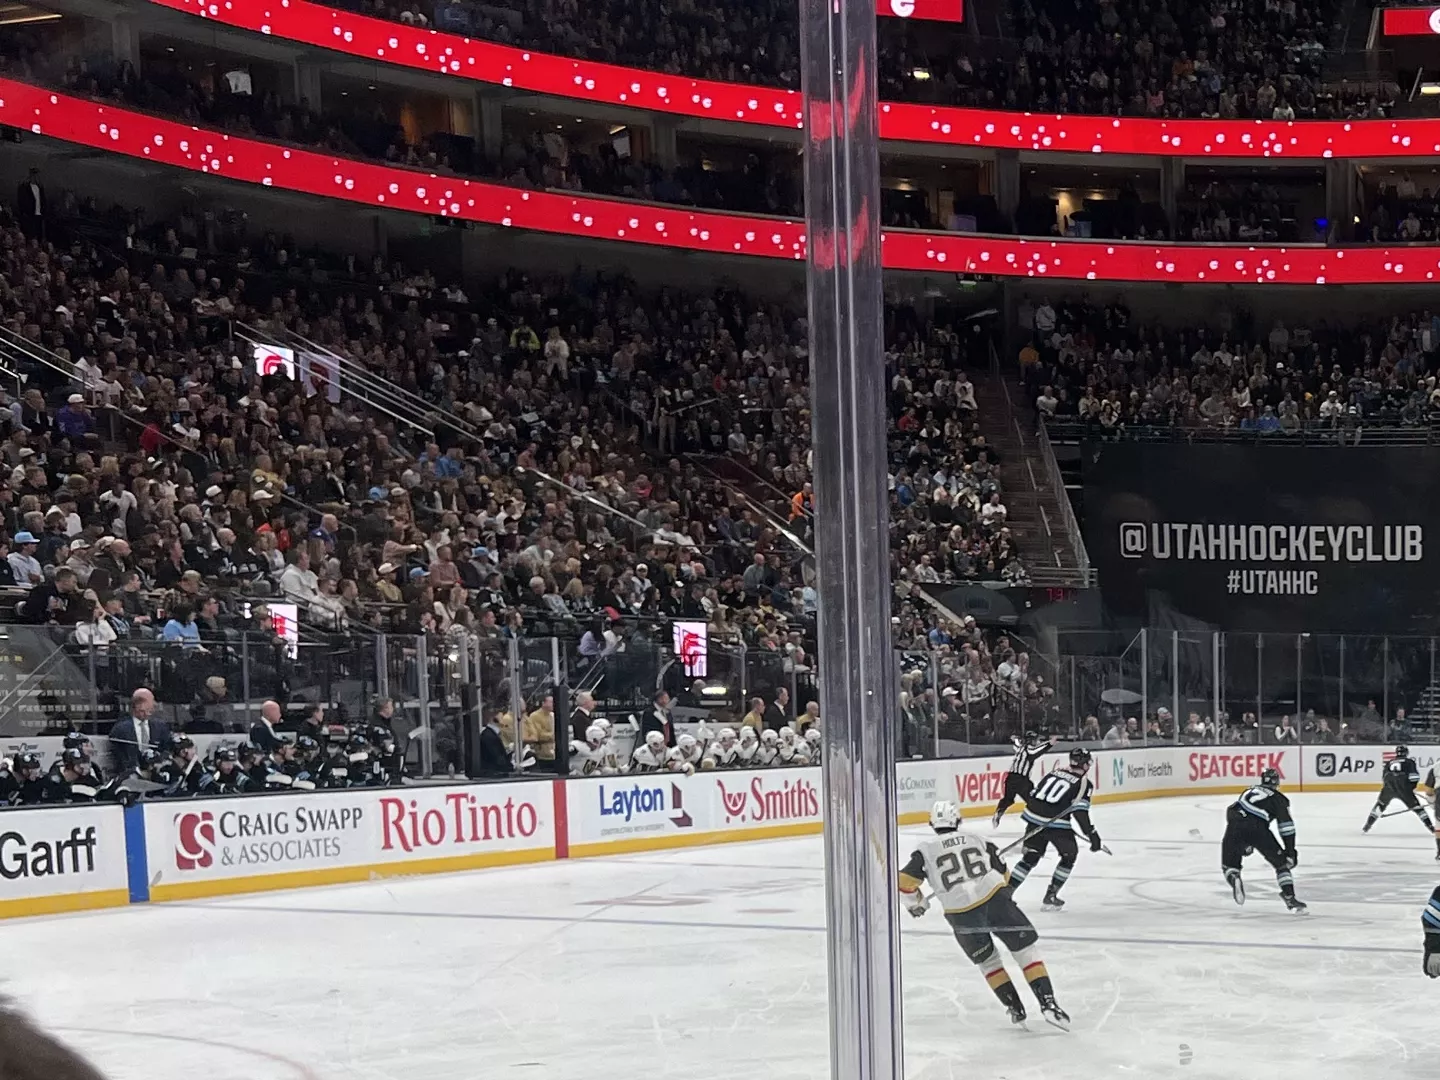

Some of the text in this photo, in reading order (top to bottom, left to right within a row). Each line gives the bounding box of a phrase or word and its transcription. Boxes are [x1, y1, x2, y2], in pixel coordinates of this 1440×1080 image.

[1120, 522, 1423, 562] @UTAHHOCKEYCLUB
[1227, 569, 1318, 595] #UTAHHC
[1148, 761, 1173, 778] Health
[1188, 751, 1287, 782] SEATGEEK
[599, 783, 665, 823] Layton
[751, 776, 820, 821] Smith's
[1035, 775, 1071, 804] 10
[219, 806, 364, 839] CRAIG SWAPP
[0, 826, 97, 881] Garff
[221, 836, 342, 866] & ASSOCIATES
[935, 846, 988, 892] 26
